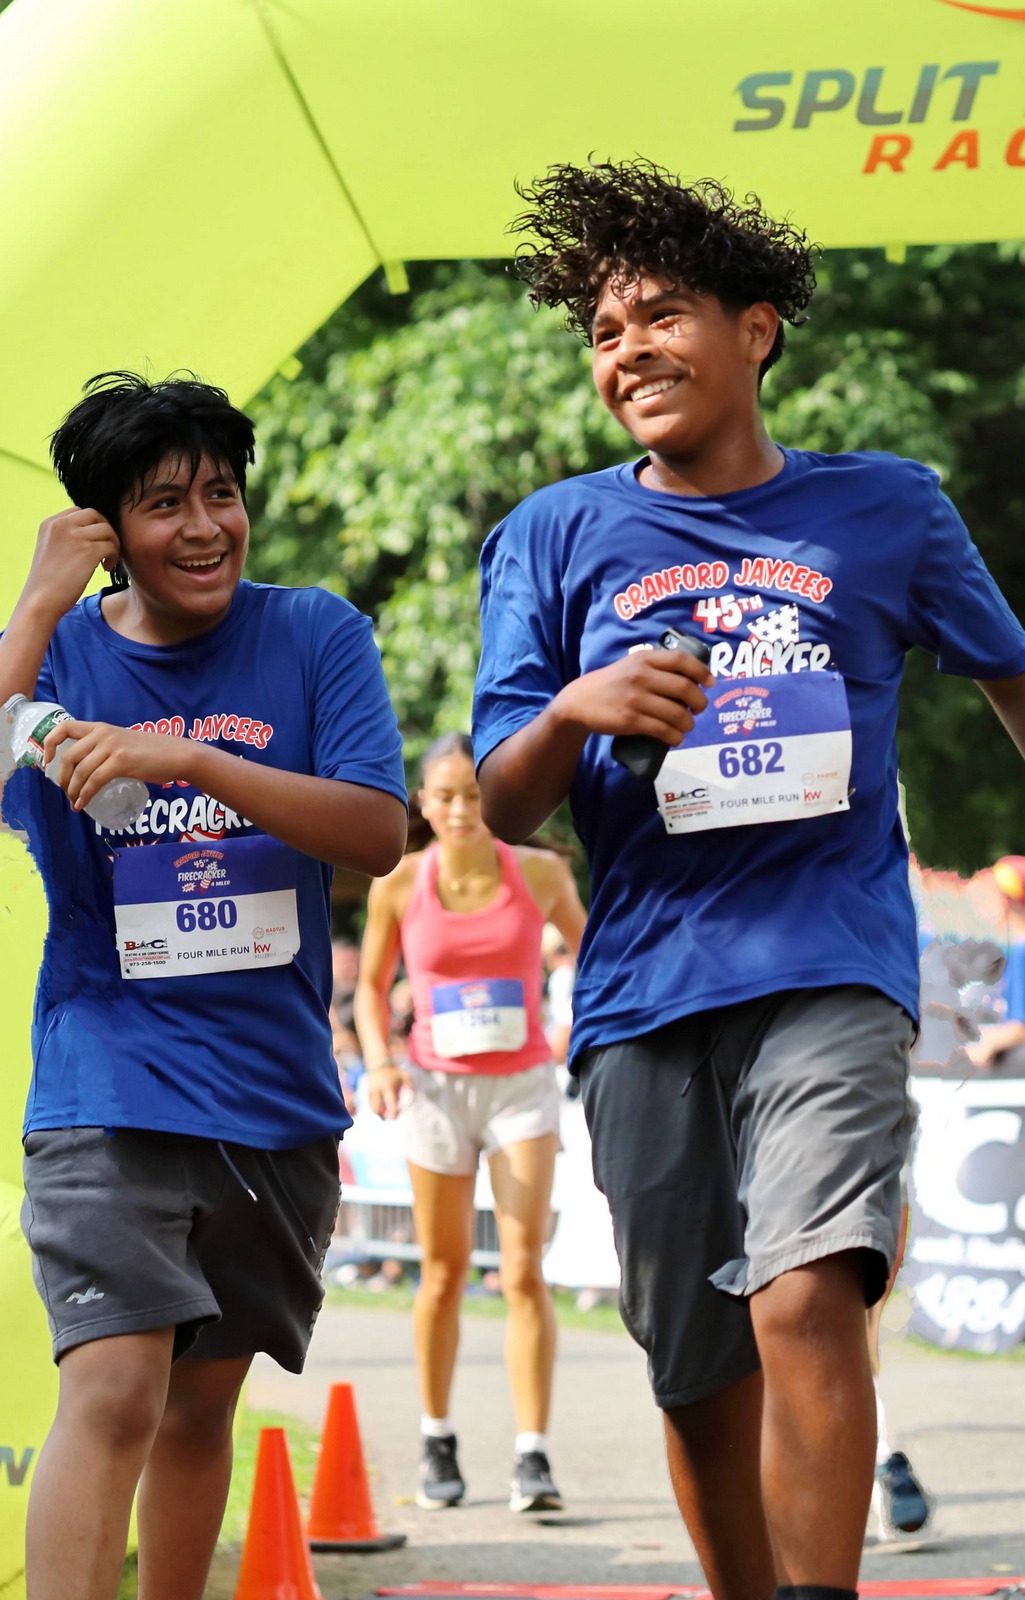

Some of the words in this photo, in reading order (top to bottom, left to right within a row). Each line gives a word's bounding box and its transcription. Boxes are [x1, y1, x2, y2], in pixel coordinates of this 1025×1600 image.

[732, 60, 1000, 132] SPLIT
[613, 561, 729, 621] CRANFORD
[734, 557, 832, 604] JAYCEES
[692, 594, 763, 633] 45TH
[718, 707, 772, 724] FIRECRACKER
[188, 713, 273, 750] JAYCEES
[718, 742, 785, 779] 682
[720, 797, 749, 809] FOUR
[752, 794, 775, 805] MILE
[778, 793, 799, 802] RUN
[803, 788, 822, 802] kw
[177, 868, 227, 882] FIRECRACKER
[176, 899, 238, 933] 680
[177, 950, 203, 960] FOUR
[206, 948, 228, 958] MILE
[230, 946, 250, 955] RUN
[253, 941, 271, 954] kw
